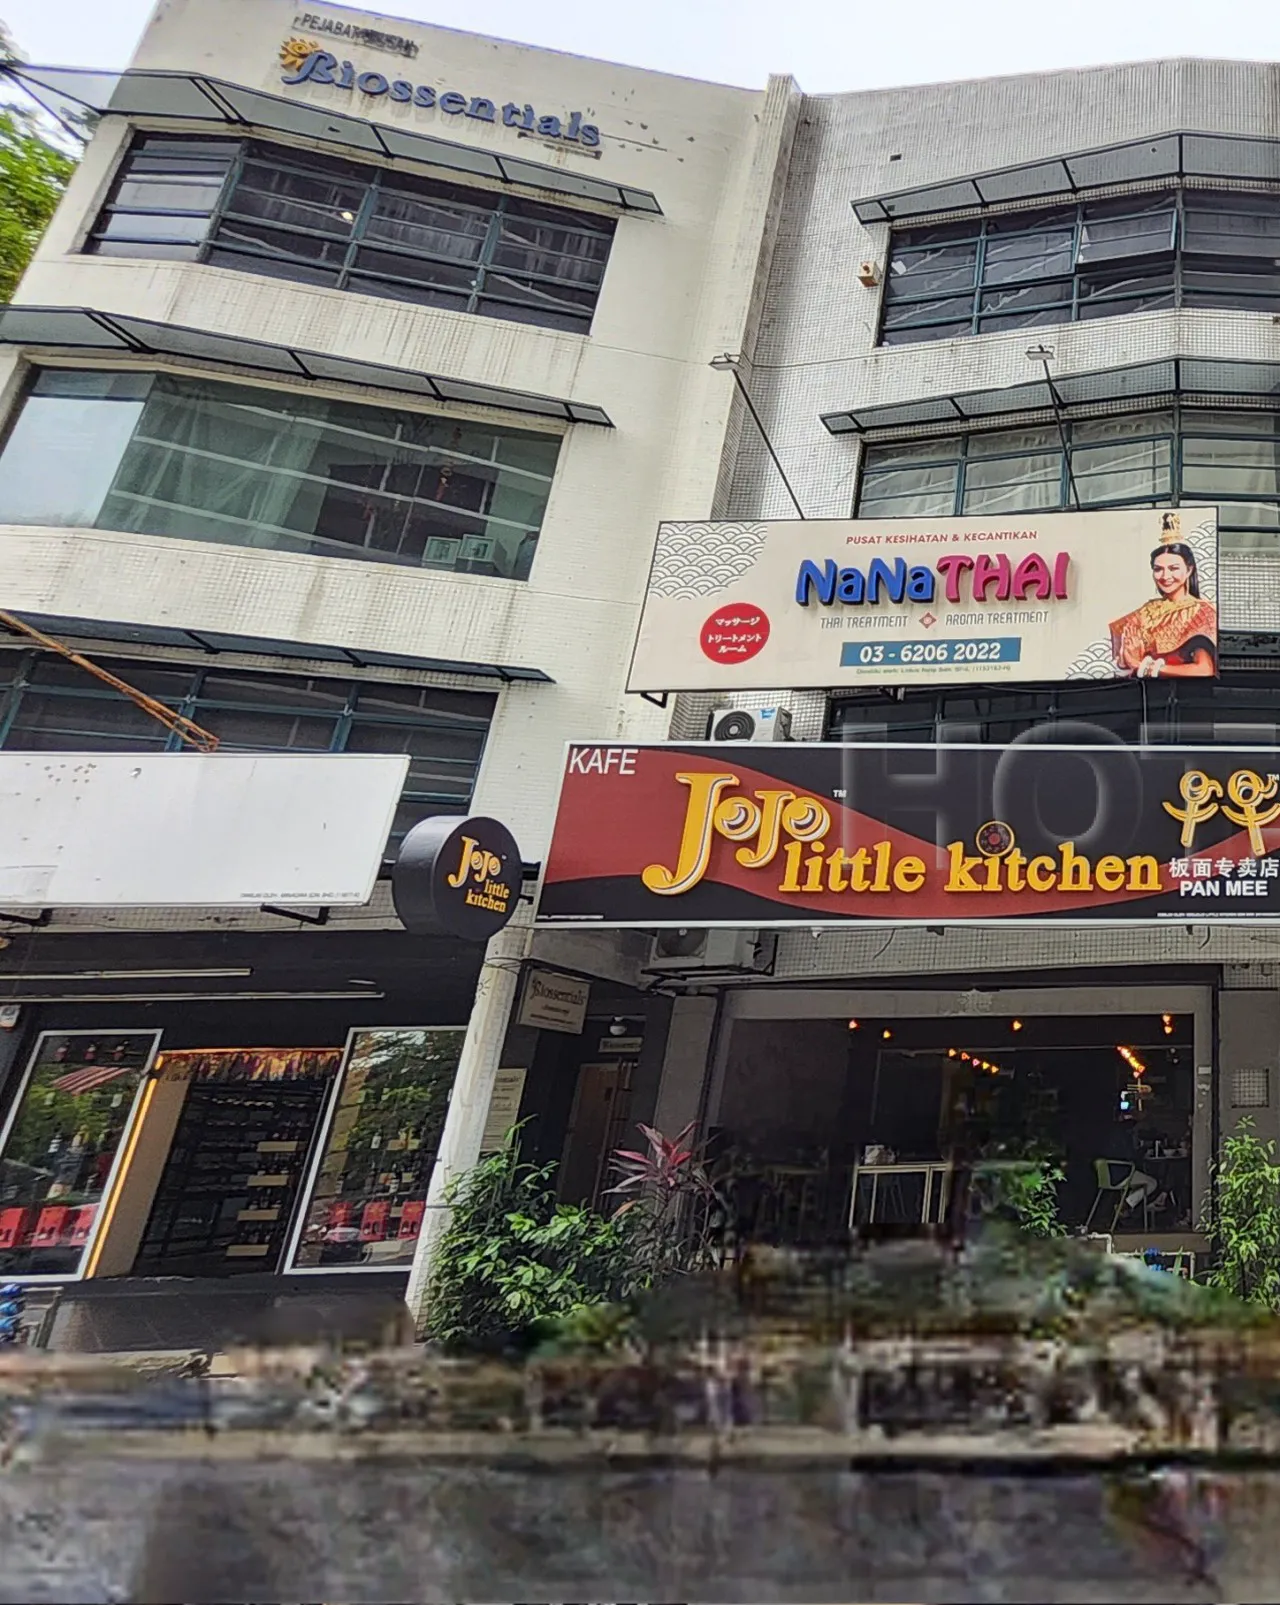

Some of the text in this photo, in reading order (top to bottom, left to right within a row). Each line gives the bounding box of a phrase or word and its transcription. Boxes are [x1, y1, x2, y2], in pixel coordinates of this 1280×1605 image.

[281, 50, 600, 147] Biossentials
[845, 530, 1038, 545] PUSAT KESIHATAN & KECANTIKAN
[820, 611, 1049, 629] THAI TREATMENT AROMA TREATMENT
[707, 633, 762, 644] トリートメント
[717, 645, 747, 654] ルーム
[859, 645, 884, 663] 03
[900, 643, 949, 662] 6206
[953, 642, 1002, 661] 2022
[569, 748, 637, 775] KAFE
[779, 836, 1162, 893] little kitchen
[1168, 856, 1280, 879] 板面专卖店
[484, 878, 510, 899] little
[1180, 880, 1268, 897] PAN MEE
[465, 888, 507, 913] kitchen
